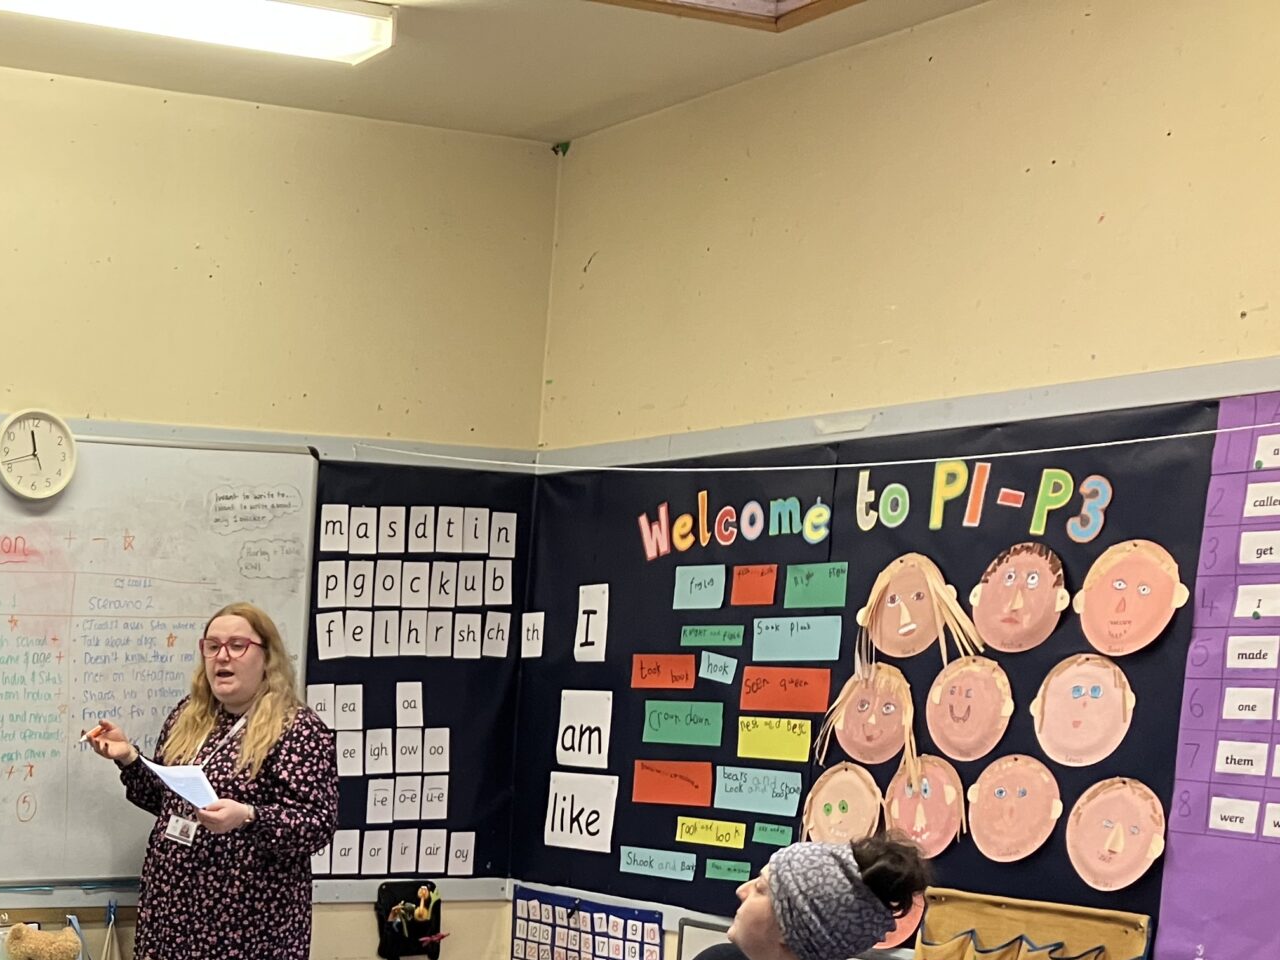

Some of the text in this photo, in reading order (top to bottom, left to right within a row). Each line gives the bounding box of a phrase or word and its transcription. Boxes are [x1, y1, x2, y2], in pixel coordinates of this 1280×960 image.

[637, 459, 1114, 562] Welcome to P1-P3
[1208, 487, 1225, 518] 2
[325, 519, 344, 535] m
[356, 522, 369, 539] a
[387, 521, 397, 538] s
[415, 514, 428, 539] d
[446, 518, 455, 538] t
[473, 517, 479, 539] i
[497, 526, 509, 543] n
[1203, 537, 1219, 570] 3
[1255, 545, 1274, 559] get
[325, 574, 338, 599] p
[353, 573, 365, 597] g
[382, 574, 394, 591] o
[410, 576, 421, 593] c
[438, 571, 450, 595] k
[464, 574, 476, 591] u
[492, 568, 504, 592] b
[1201, 588, 1218, 617] 4
[325, 620, 335, 647] f
[352, 625, 364, 641] e
[383, 620, 389, 644] l
[407, 620, 419, 644] h
[434, 624, 443, 642] r
[458, 625, 476, 642] sh
[487, 622, 505, 640] ch
[526, 623, 540, 641] th
[579, 609, 598, 648] I
[1190, 638, 1213, 667] 5
[1237, 650, 1269, 661] made
[706, 655, 730, 675] hook
[315, 698, 327, 712] ai
[341, 702, 356, 712] ea
[402, 699, 418, 710] oa
[1189, 688, 1204, 718] 6
[1237, 703, 1258, 712] one
[684, 705, 712, 727] down
[561, 723, 603, 756] am
[342, 748, 356, 759] ee
[370, 742, 388, 760] igh
[400, 744, 419, 756] ow
[429, 745, 444, 756] oo
[1184, 743, 1201, 768] 7
[1225, 754, 1254, 767] them
[1178, 790, 1191, 818] 8
[550, 791, 601, 837] like
[1219, 813, 1245, 825] were
[339, 846, 353, 857] ar
[369, 846, 382, 857] or
[400, 842, 409, 856] ir
[425, 843, 441, 857] air
[454, 848, 470, 862] oy
[646, 928, 656, 940] 10
[628, 946, 637, 958] 19
